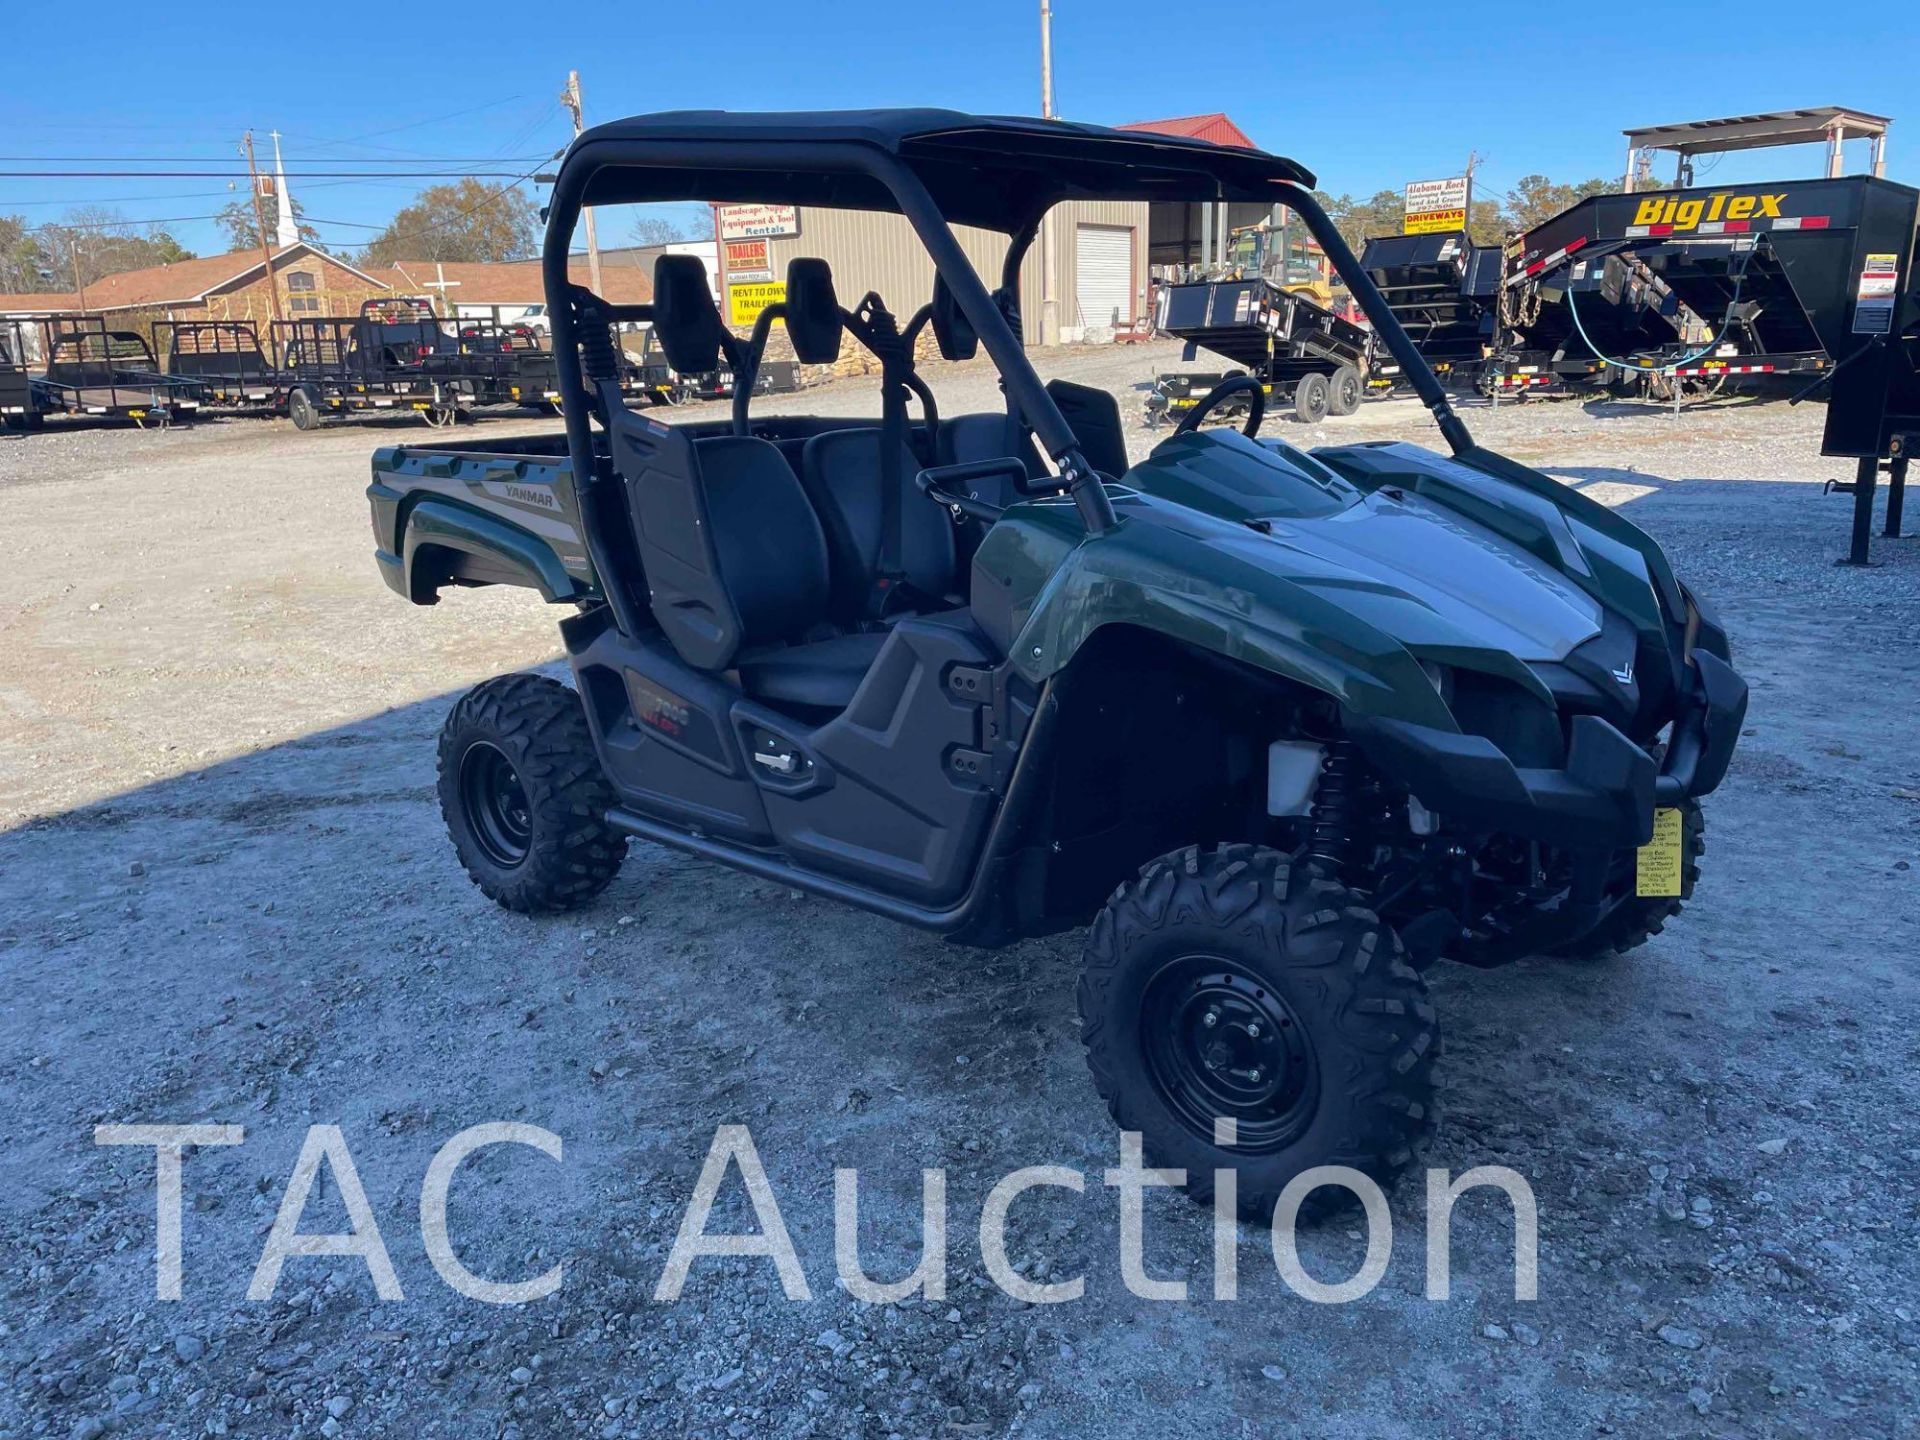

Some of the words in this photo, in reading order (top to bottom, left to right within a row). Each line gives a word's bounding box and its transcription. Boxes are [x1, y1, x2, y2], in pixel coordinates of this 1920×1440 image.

[1408, 184, 1442, 193] Alabama
[1445, 179, 1465, 189] Rock
[1408, 199, 1424, 207] Sand
[723, 207, 763, 217] Landscape
[1406, 210, 1464, 222] DRIVEWAYS
[1632, 191, 1788, 231] BigTex
[722, 217, 766, 230] Equipment
[768, 215, 775, 223] &
[745, 225, 785, 236] Rentals
[727, 243, 766, 260] TRAILERS
[732, 288, 752, 297] RENT
[755, 288, 766, 296] TO
[505, 484, 553, 508] YANMAR
